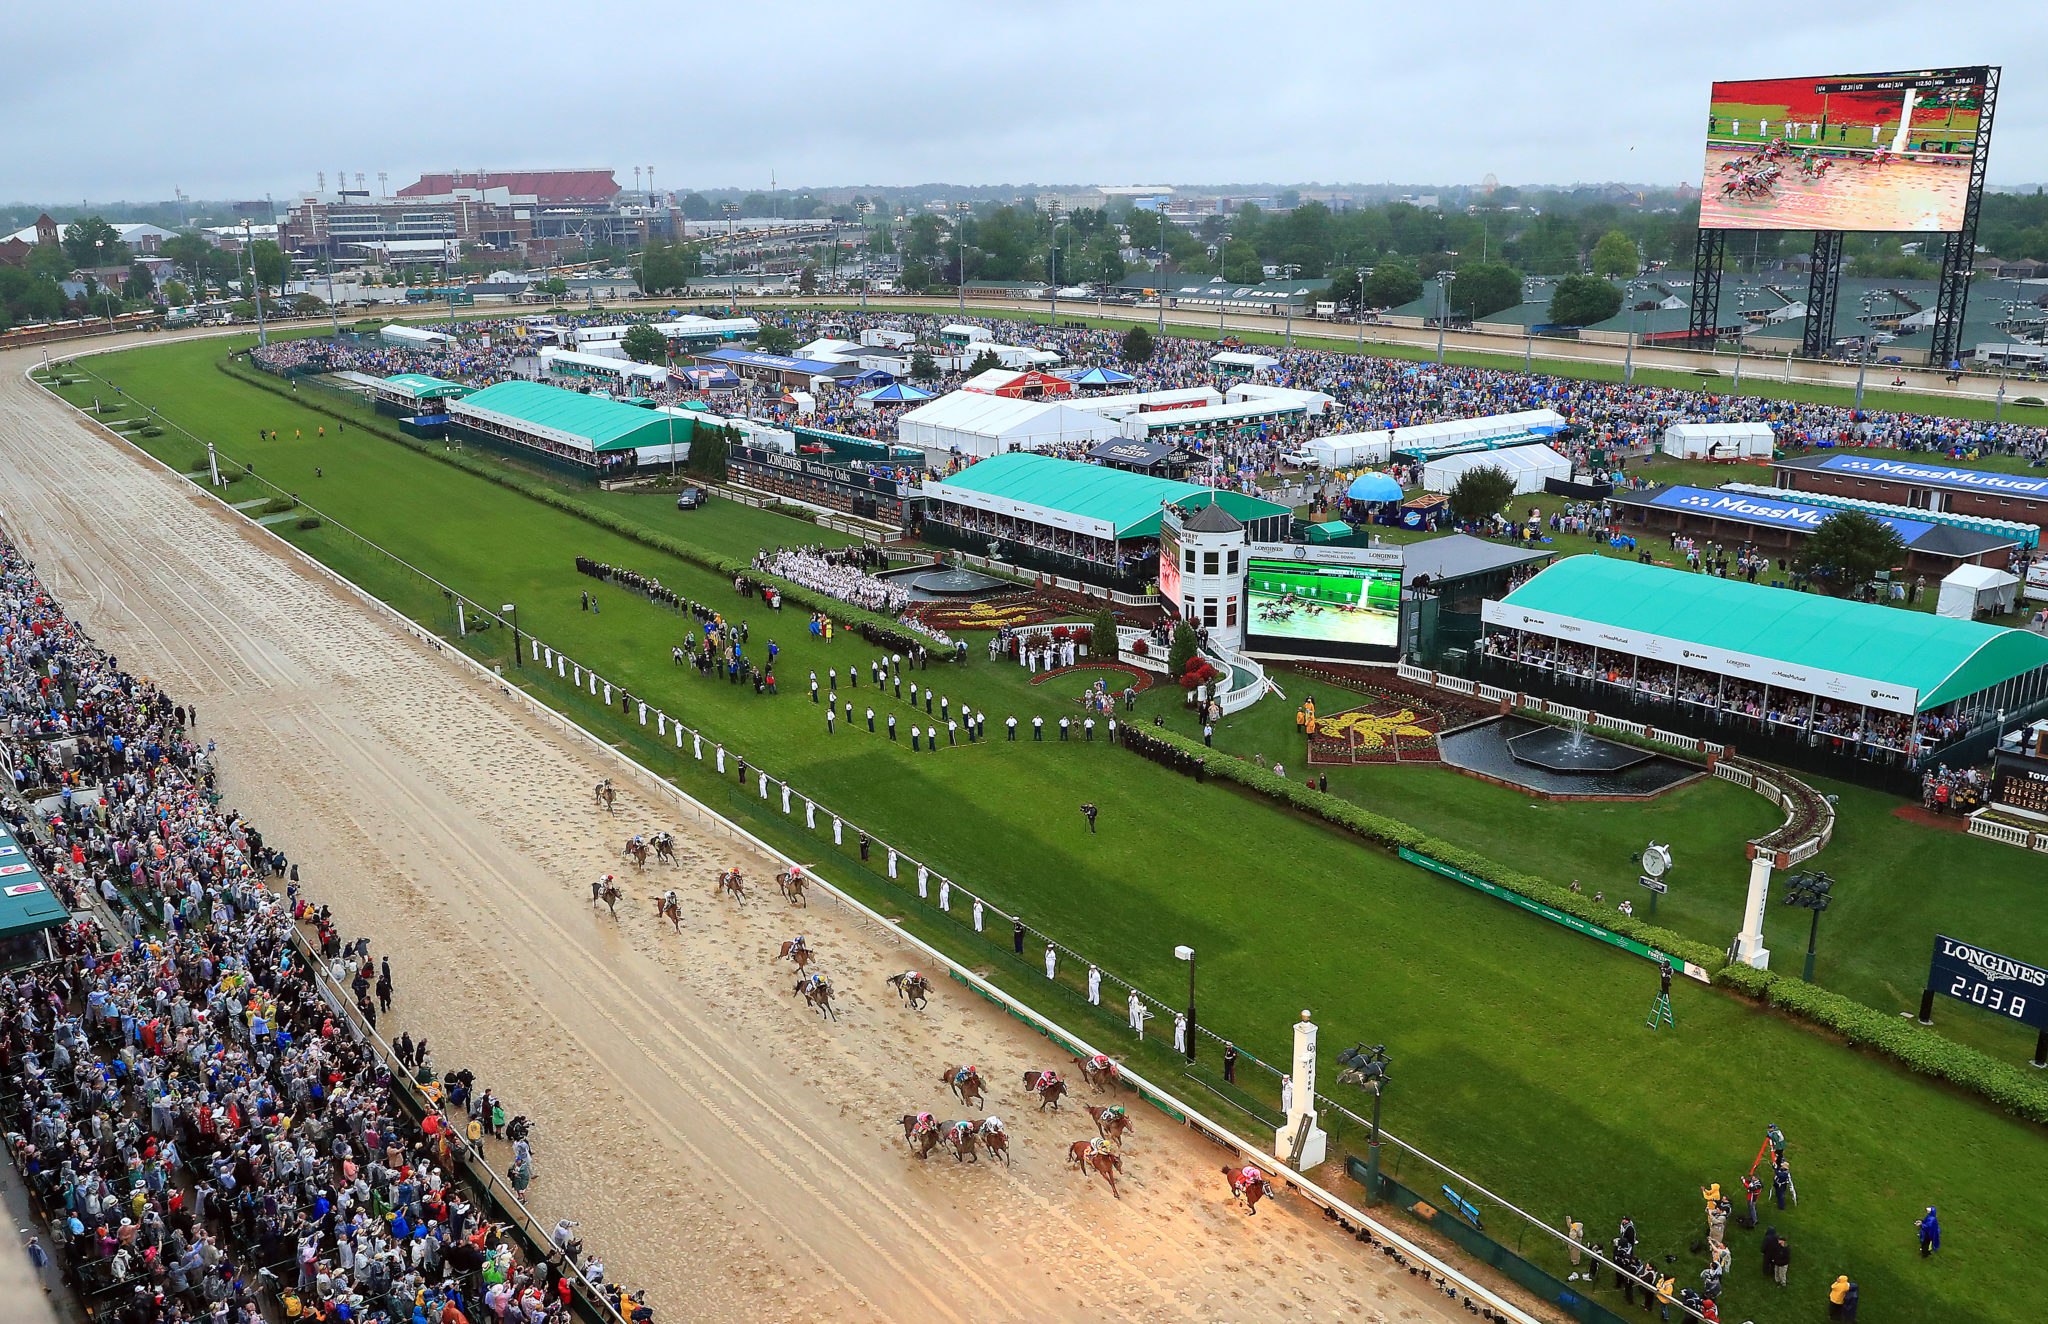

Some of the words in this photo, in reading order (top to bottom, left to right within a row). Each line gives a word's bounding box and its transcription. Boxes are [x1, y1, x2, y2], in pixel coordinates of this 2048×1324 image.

[766, 453, 802, 472] LONGINES
[806, 462, 833, 480] Kentucky
[834, 469, 850, 482] Oaks
[1872, 462, 2048, 491] MassMutual
[1943, 940, 2047, 987] LONGINES
[1950, 976, 2026, 1018] 2:03.8
